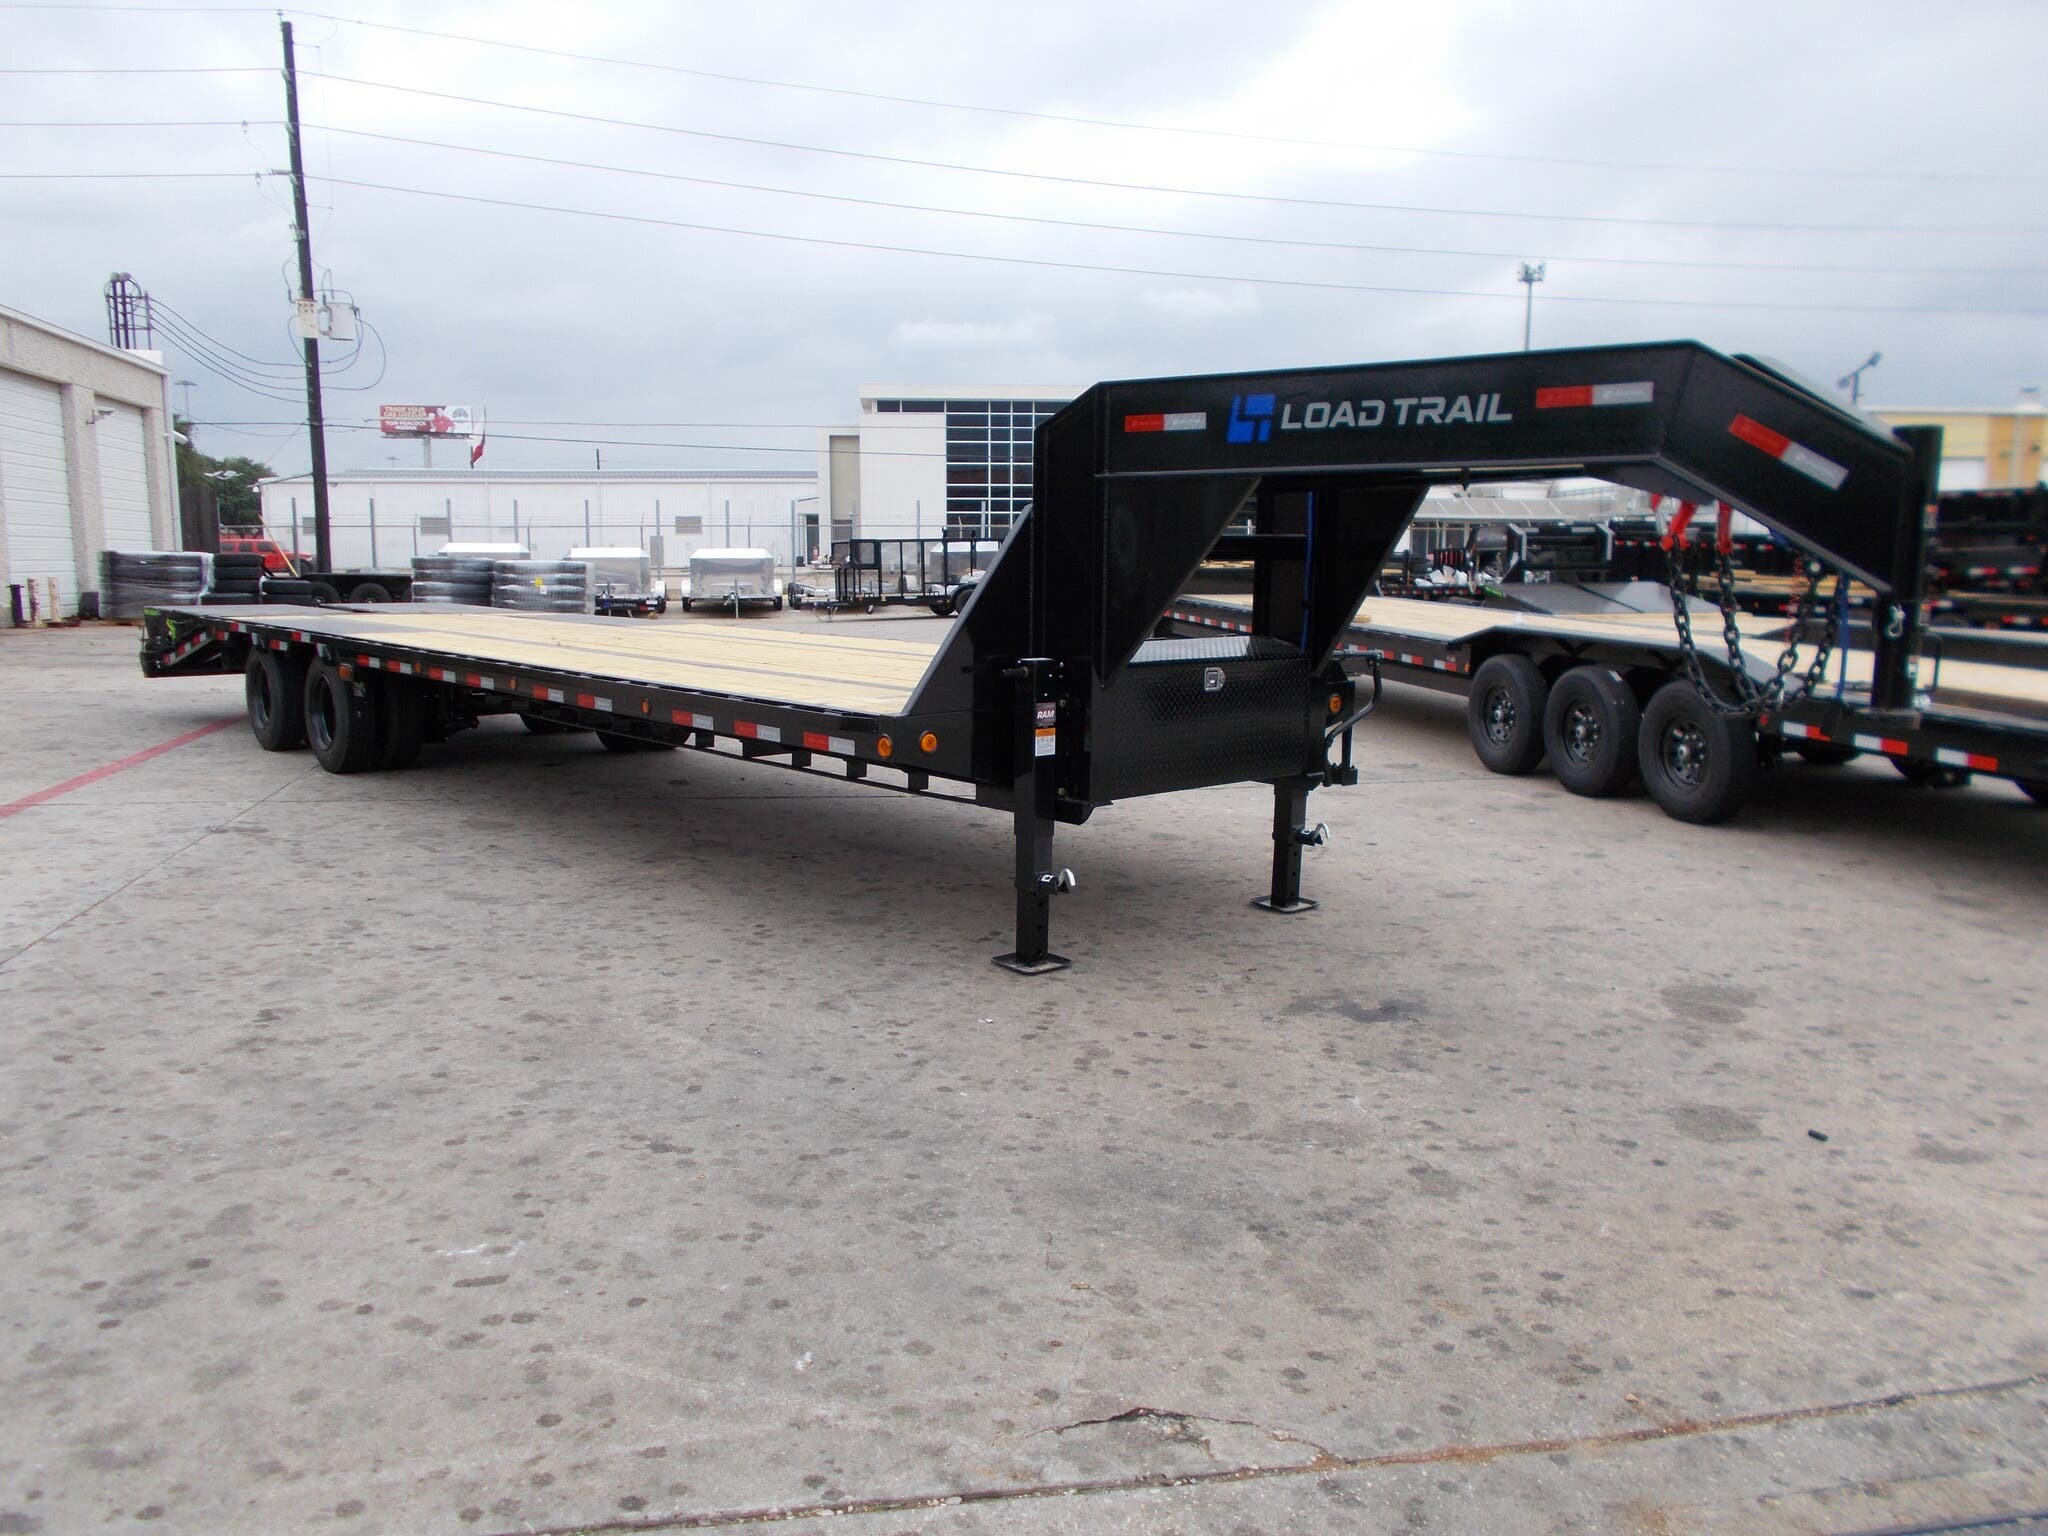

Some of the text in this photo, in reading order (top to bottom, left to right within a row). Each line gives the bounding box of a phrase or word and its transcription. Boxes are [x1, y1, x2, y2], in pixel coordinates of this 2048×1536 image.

[1281, 393, 1513, 430] LOAD TRAIL
[1037, 710, 1055, 719] RAM
